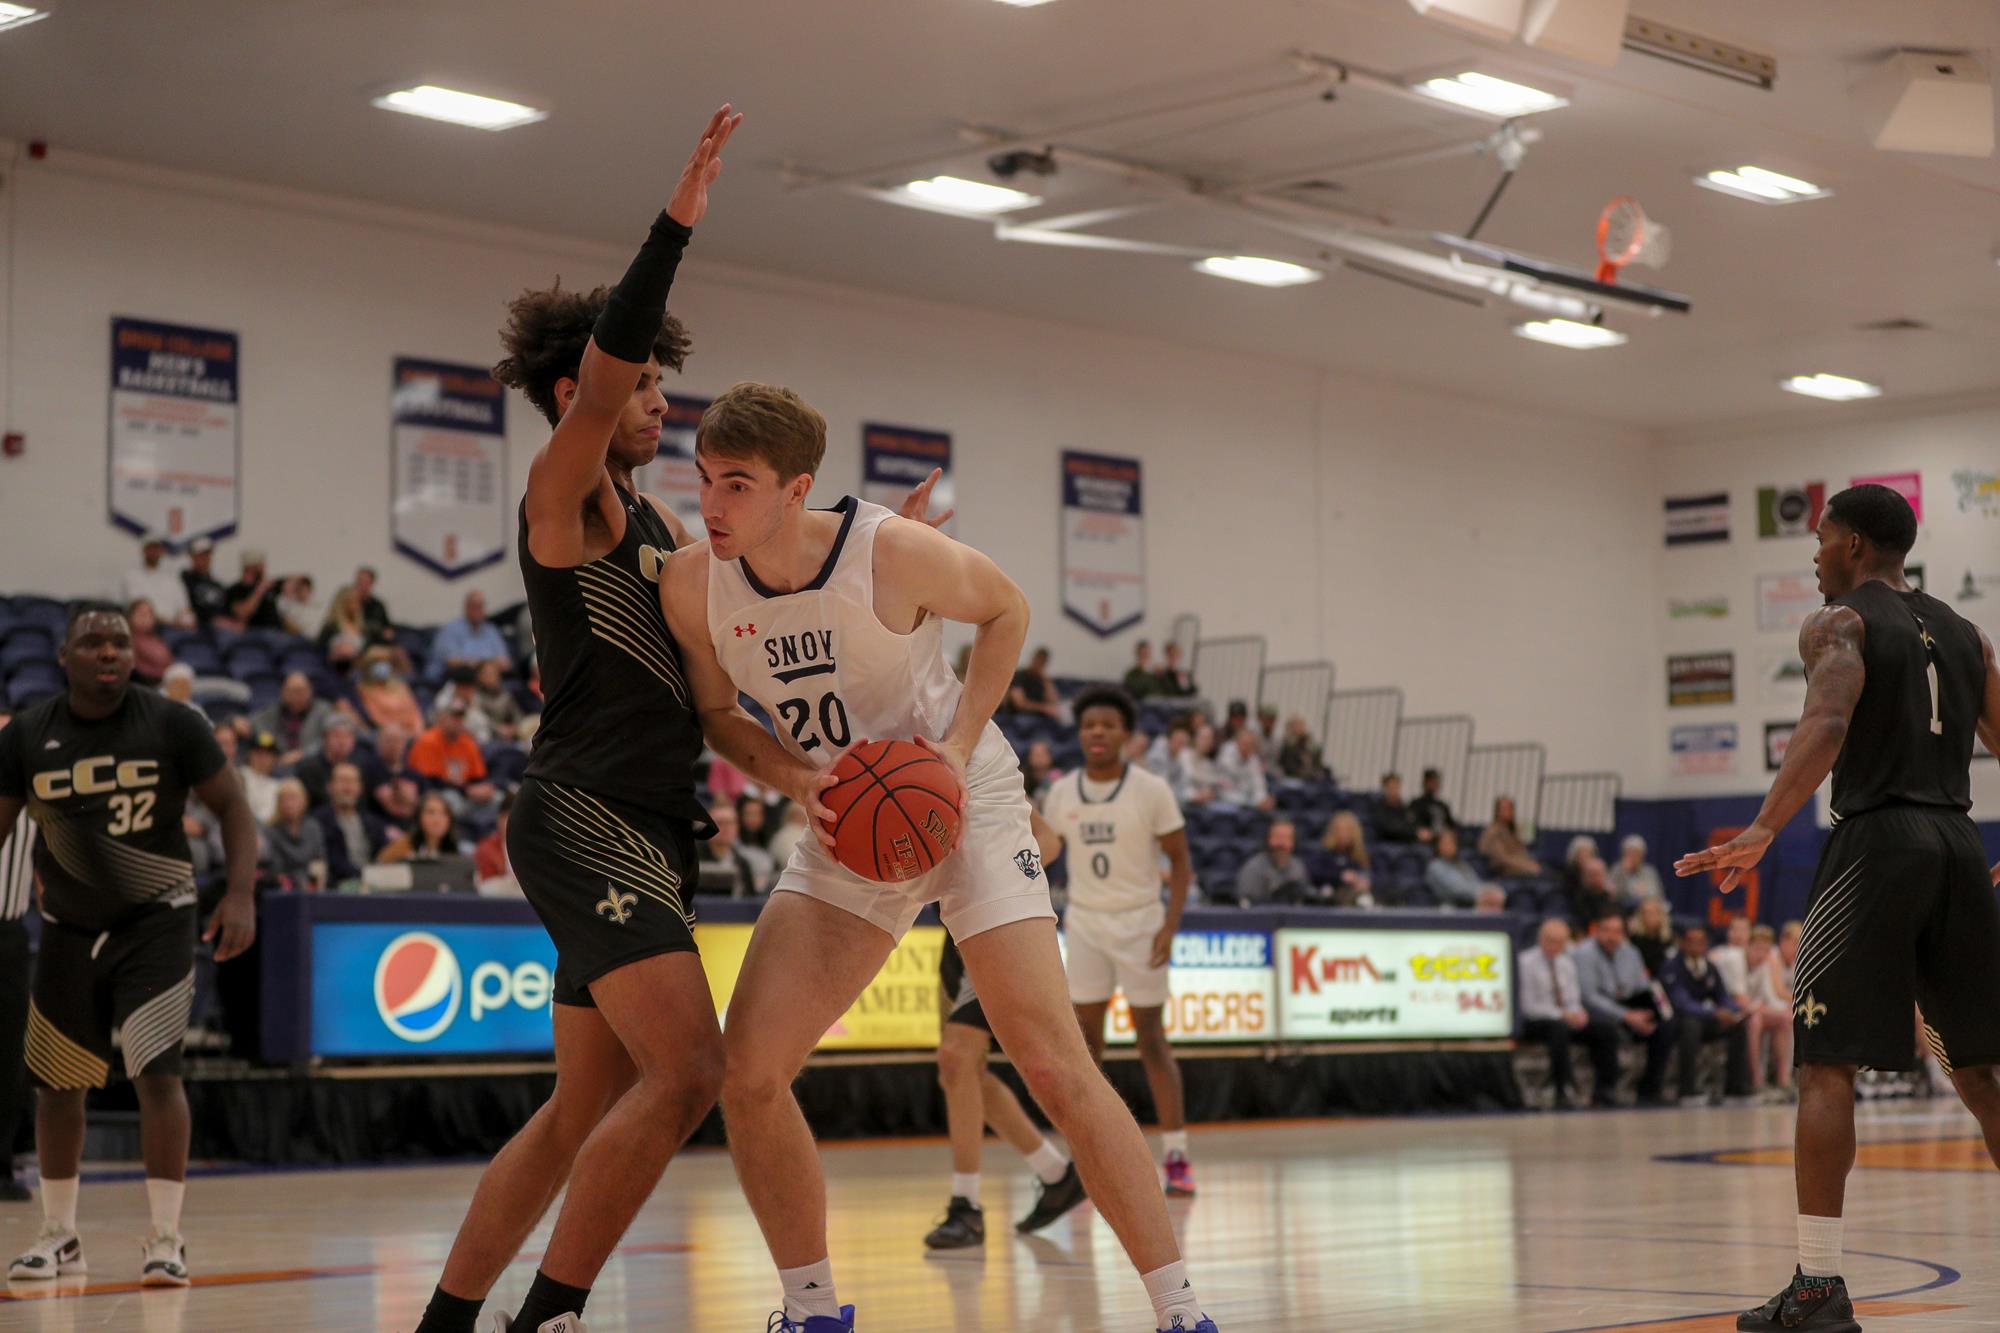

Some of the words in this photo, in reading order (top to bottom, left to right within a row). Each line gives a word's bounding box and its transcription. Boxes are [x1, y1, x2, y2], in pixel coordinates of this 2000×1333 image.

[1926, 662, 1942, 734] 1
[776, 691, 851, 752] 20
[32, 755, 160, 800] CCC
[106, 790, 157, 836] 32
[1091, 851, 1110, 879] 0
[1174, 933, 1267, 966] COLLEGE
[1329, 1007, 1398, 1025] sports
